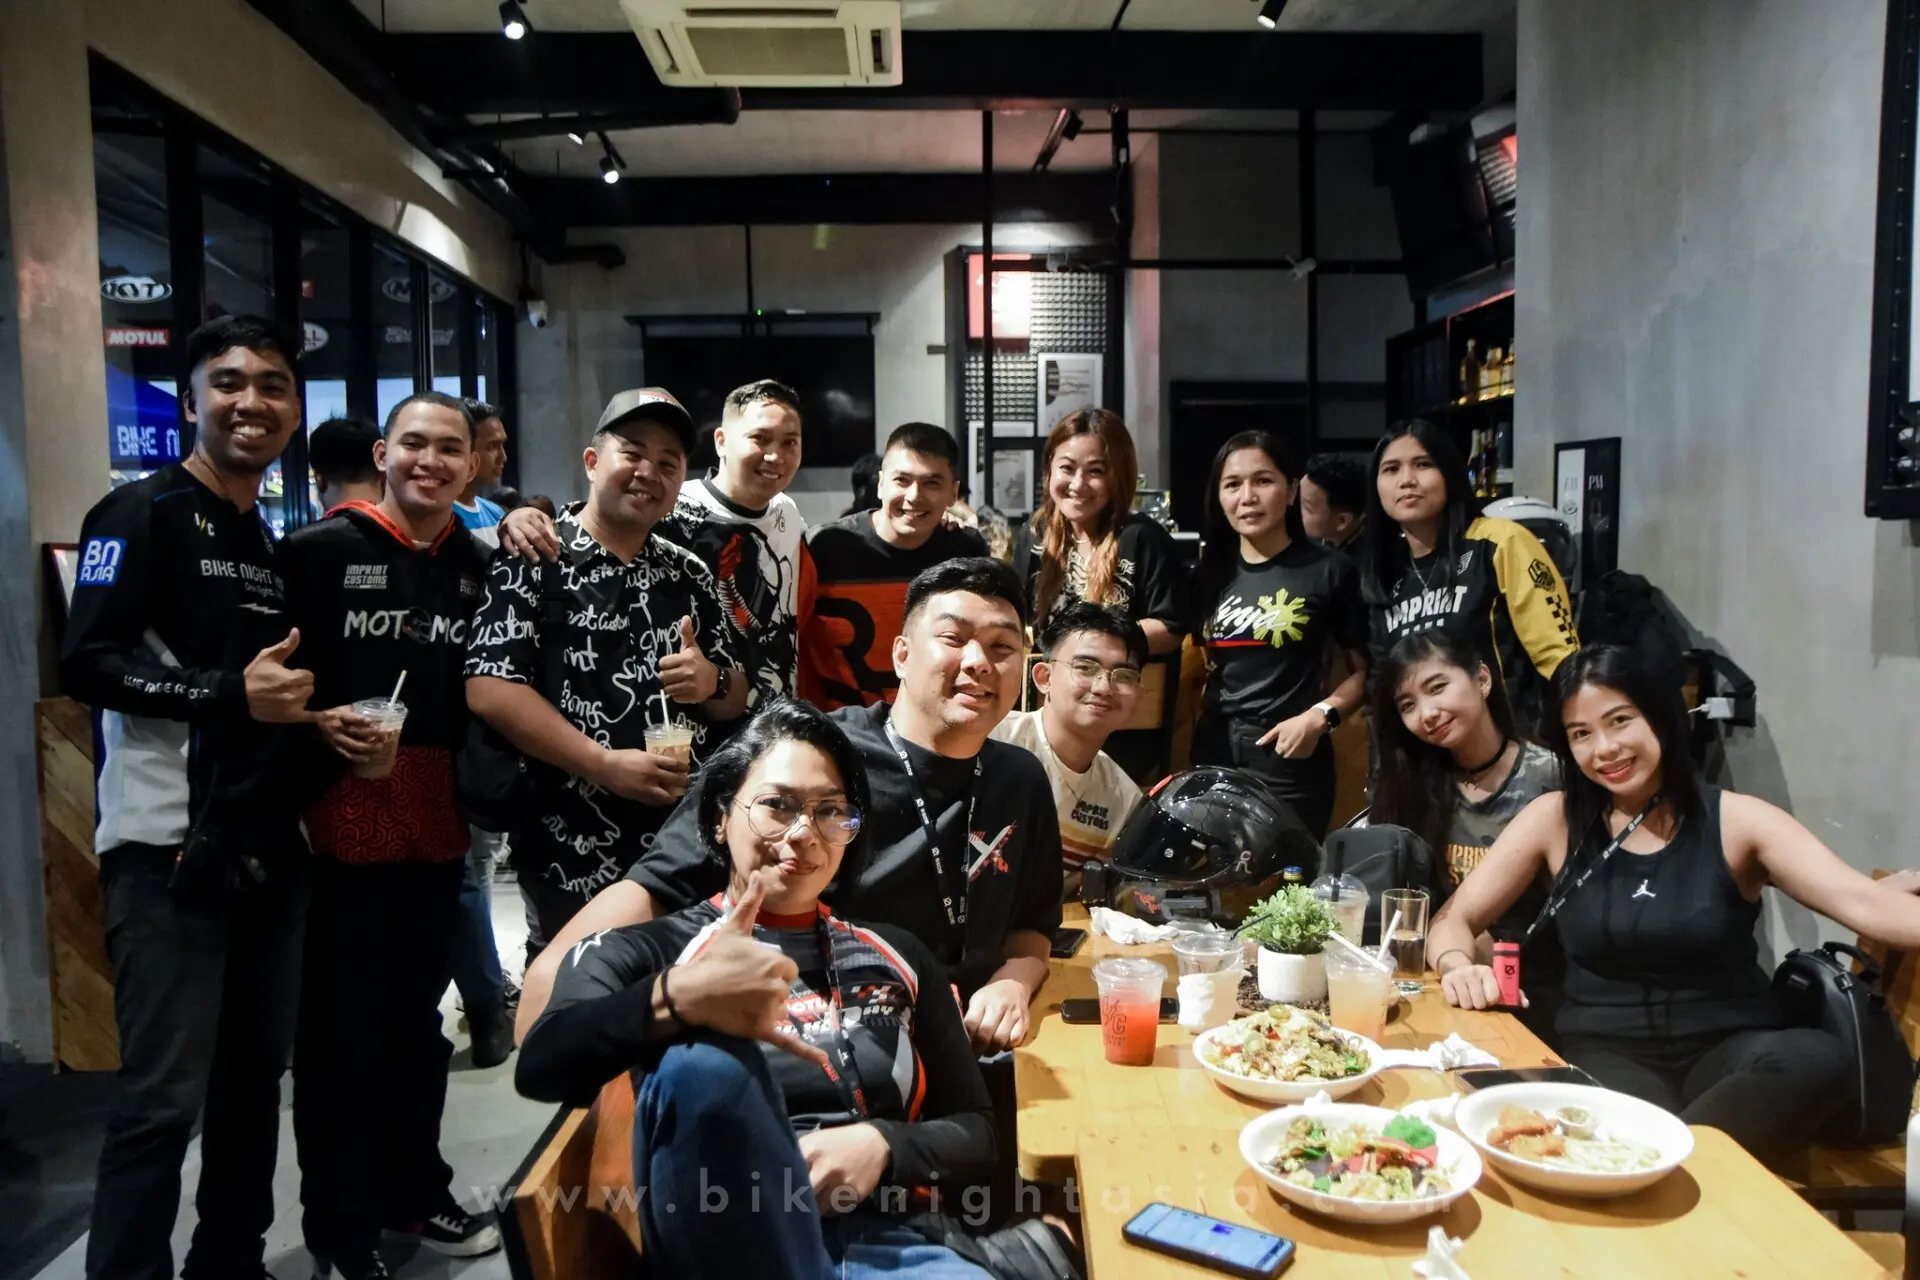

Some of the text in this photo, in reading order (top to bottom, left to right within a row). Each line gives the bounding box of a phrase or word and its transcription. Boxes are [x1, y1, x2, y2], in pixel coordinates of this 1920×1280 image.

[108, 331, 168, 345] MOTUL
[117, 425, 158, 456] BIKE
[80, 564, 115, 582] ASIA
[201, 559, 272, 584] BIKE NIGHT
[346, 564, 388, 575] IMPRINT
[344, 575, 388, 585] CUSTOMS
[1213, 595, 1288, 640] inja
